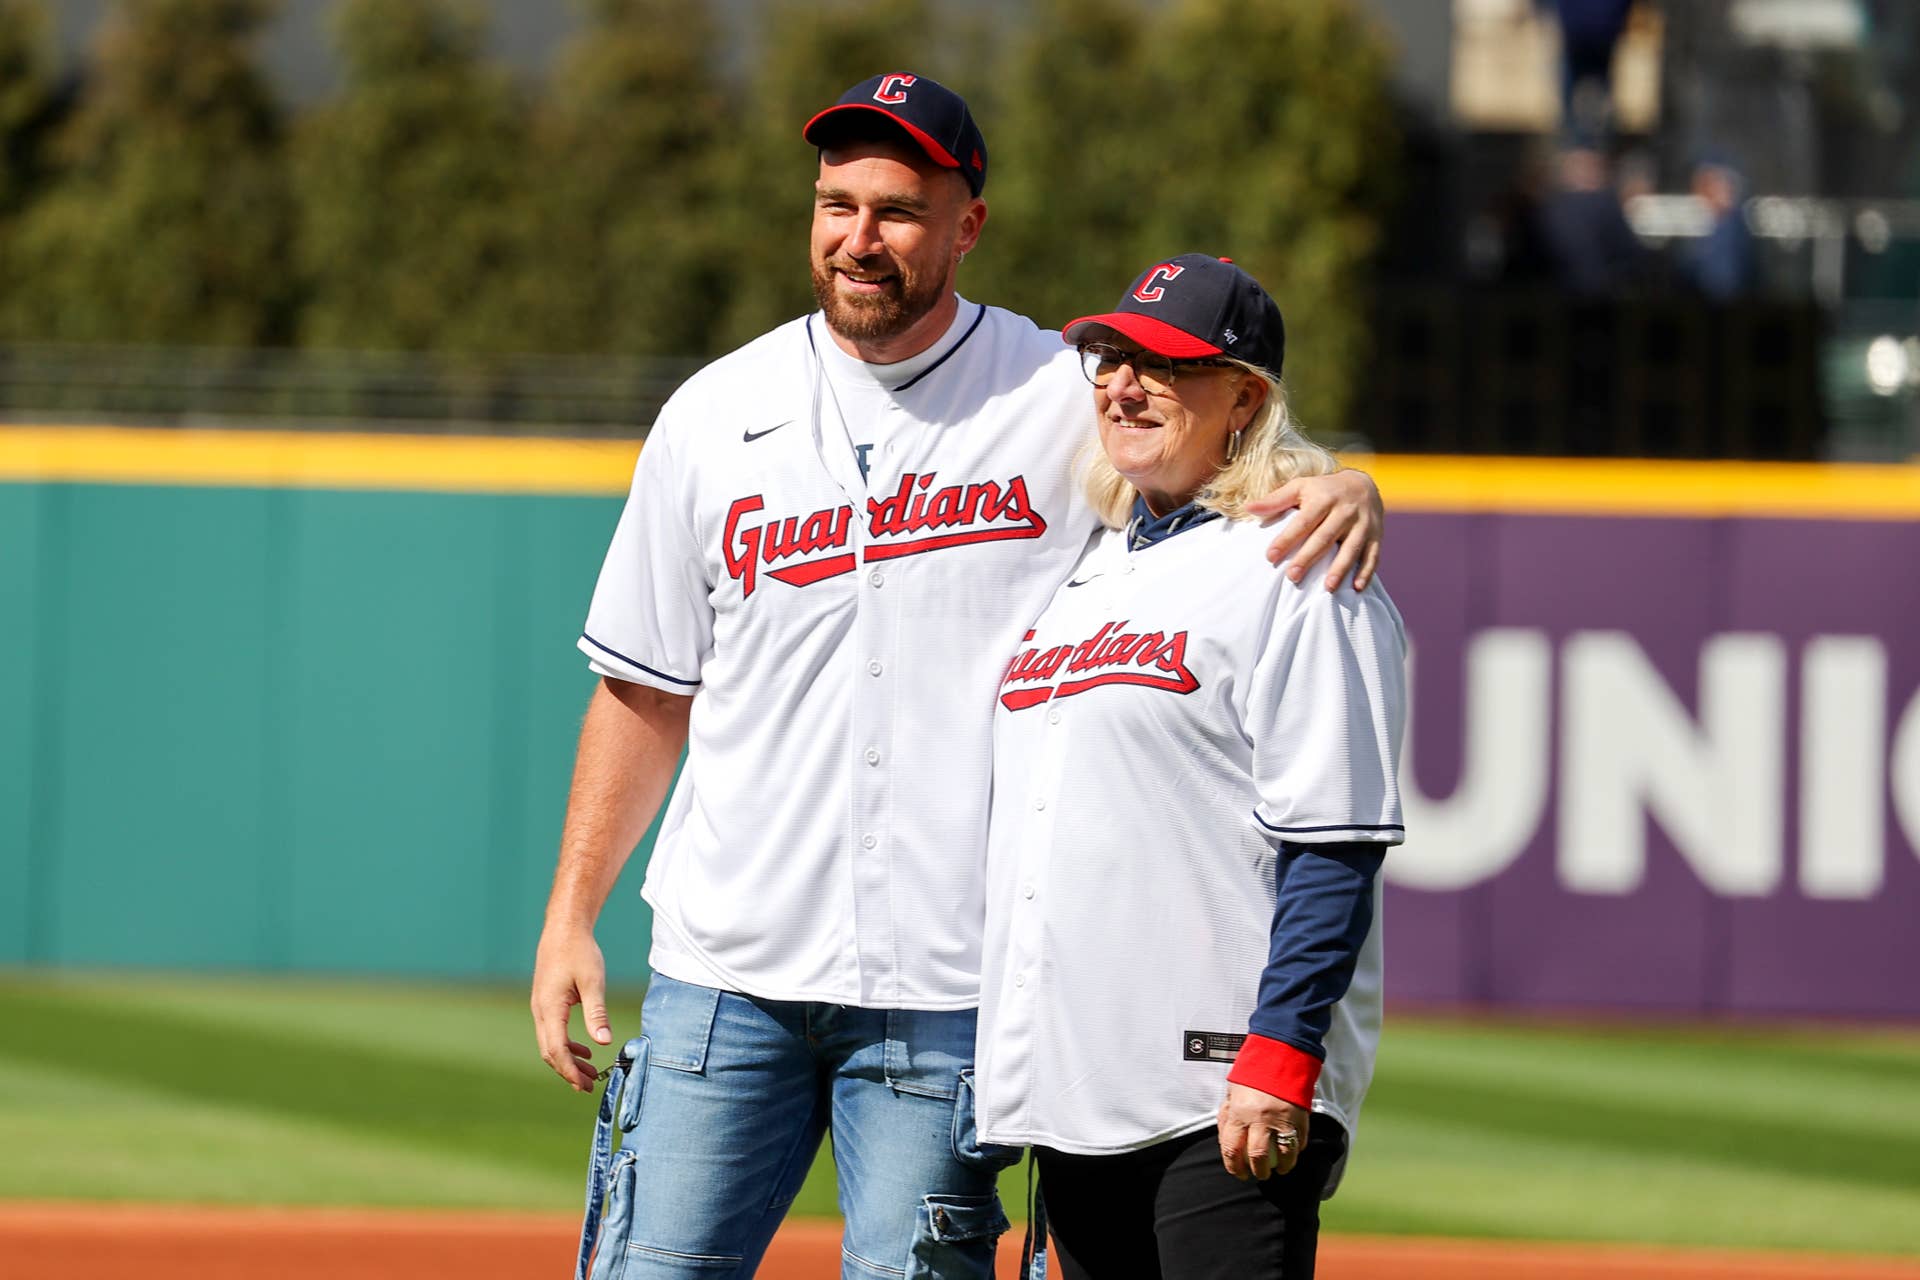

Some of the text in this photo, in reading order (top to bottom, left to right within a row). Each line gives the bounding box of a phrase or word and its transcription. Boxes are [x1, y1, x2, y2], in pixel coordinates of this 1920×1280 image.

[872, 71, 917, 105] C
[1132, 262, 1186, 304] C
[722, 472, 1046, 600] Guardians
[1002, 620, 1194, 698] uardians
[1384, 626, 1920, 900] UNI
